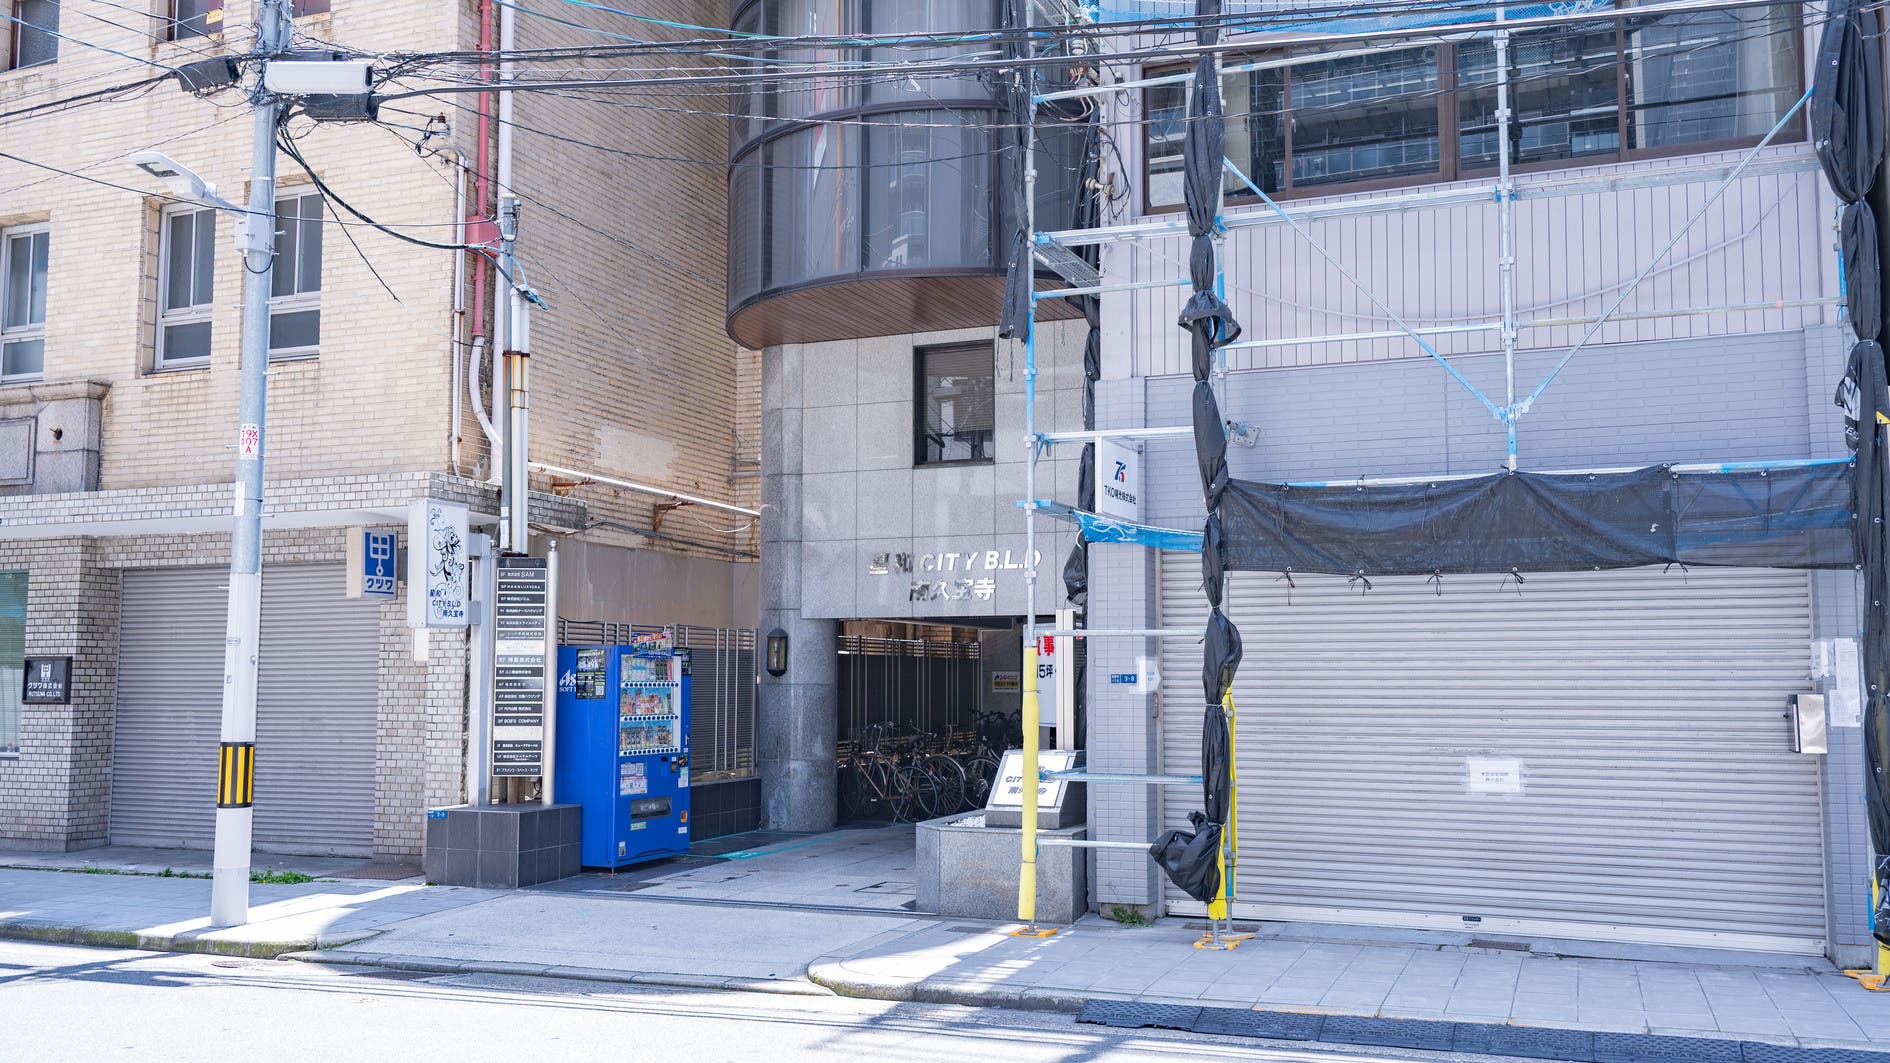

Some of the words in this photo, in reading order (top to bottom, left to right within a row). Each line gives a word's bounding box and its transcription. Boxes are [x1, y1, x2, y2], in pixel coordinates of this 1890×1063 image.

[242, 430, 258, 438] 19X
[920, 551, 979, 572] CITY
[366, 578, 393, 590] クツワ
